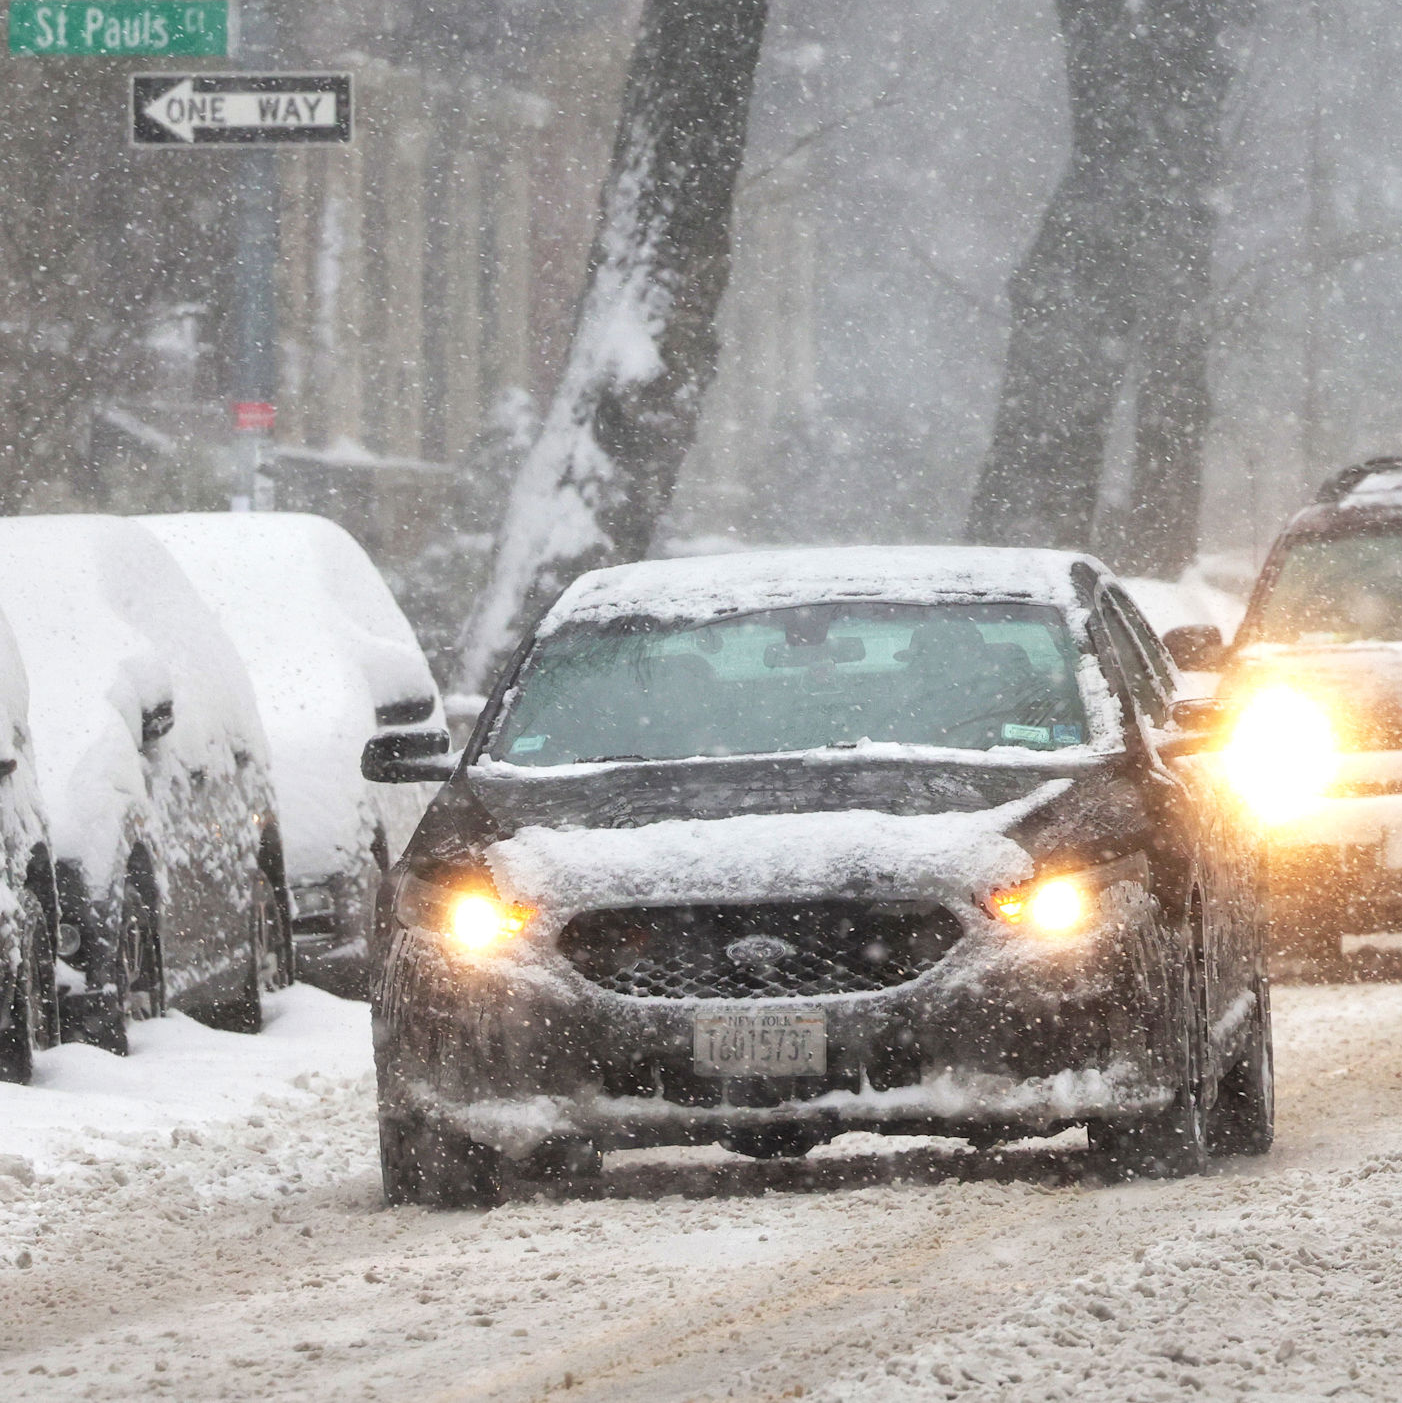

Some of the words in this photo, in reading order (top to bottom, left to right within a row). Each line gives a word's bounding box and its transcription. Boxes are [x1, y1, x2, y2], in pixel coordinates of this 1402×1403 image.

[36, 7, 68, 48] St
[85, 7, 169, 48] Pauls
[166, 97, 226, 123] ONE
[258, 97, 322, 123] WAY
